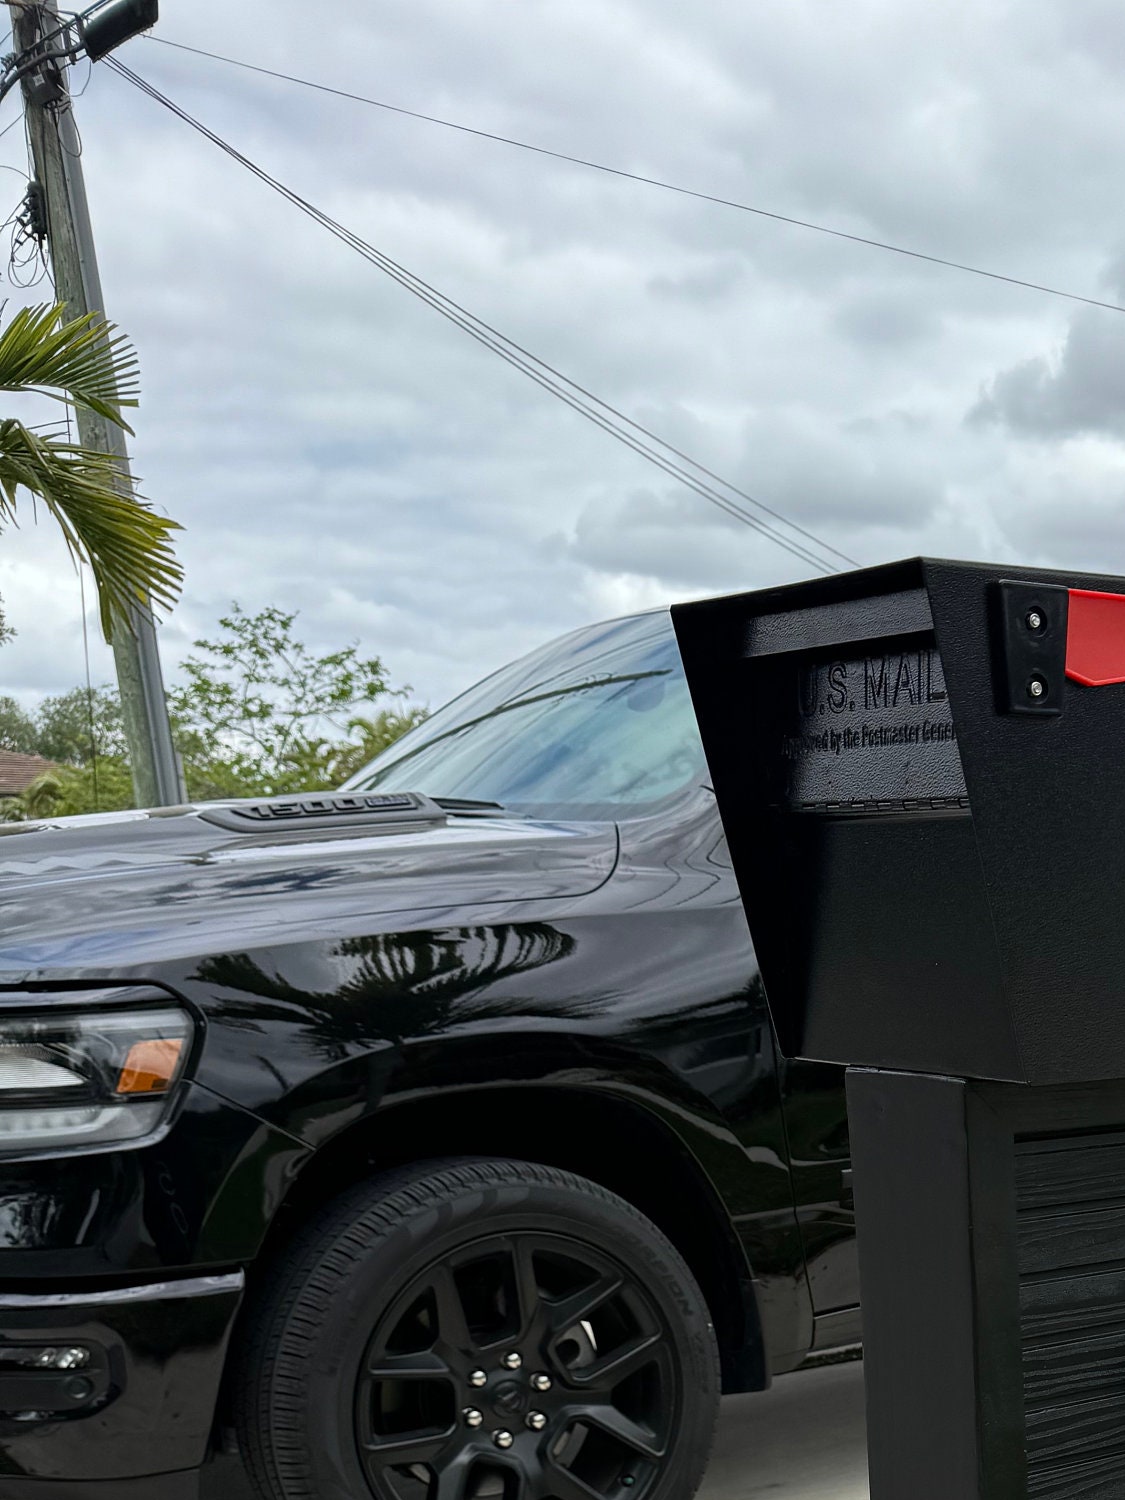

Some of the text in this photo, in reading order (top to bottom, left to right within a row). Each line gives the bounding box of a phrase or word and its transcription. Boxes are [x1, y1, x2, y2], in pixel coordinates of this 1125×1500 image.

[798, 650, 948, 717] U.S. MAIL
[862, 723, 920, 749] Postmaster
[252, 798, 364, 818] 1500
